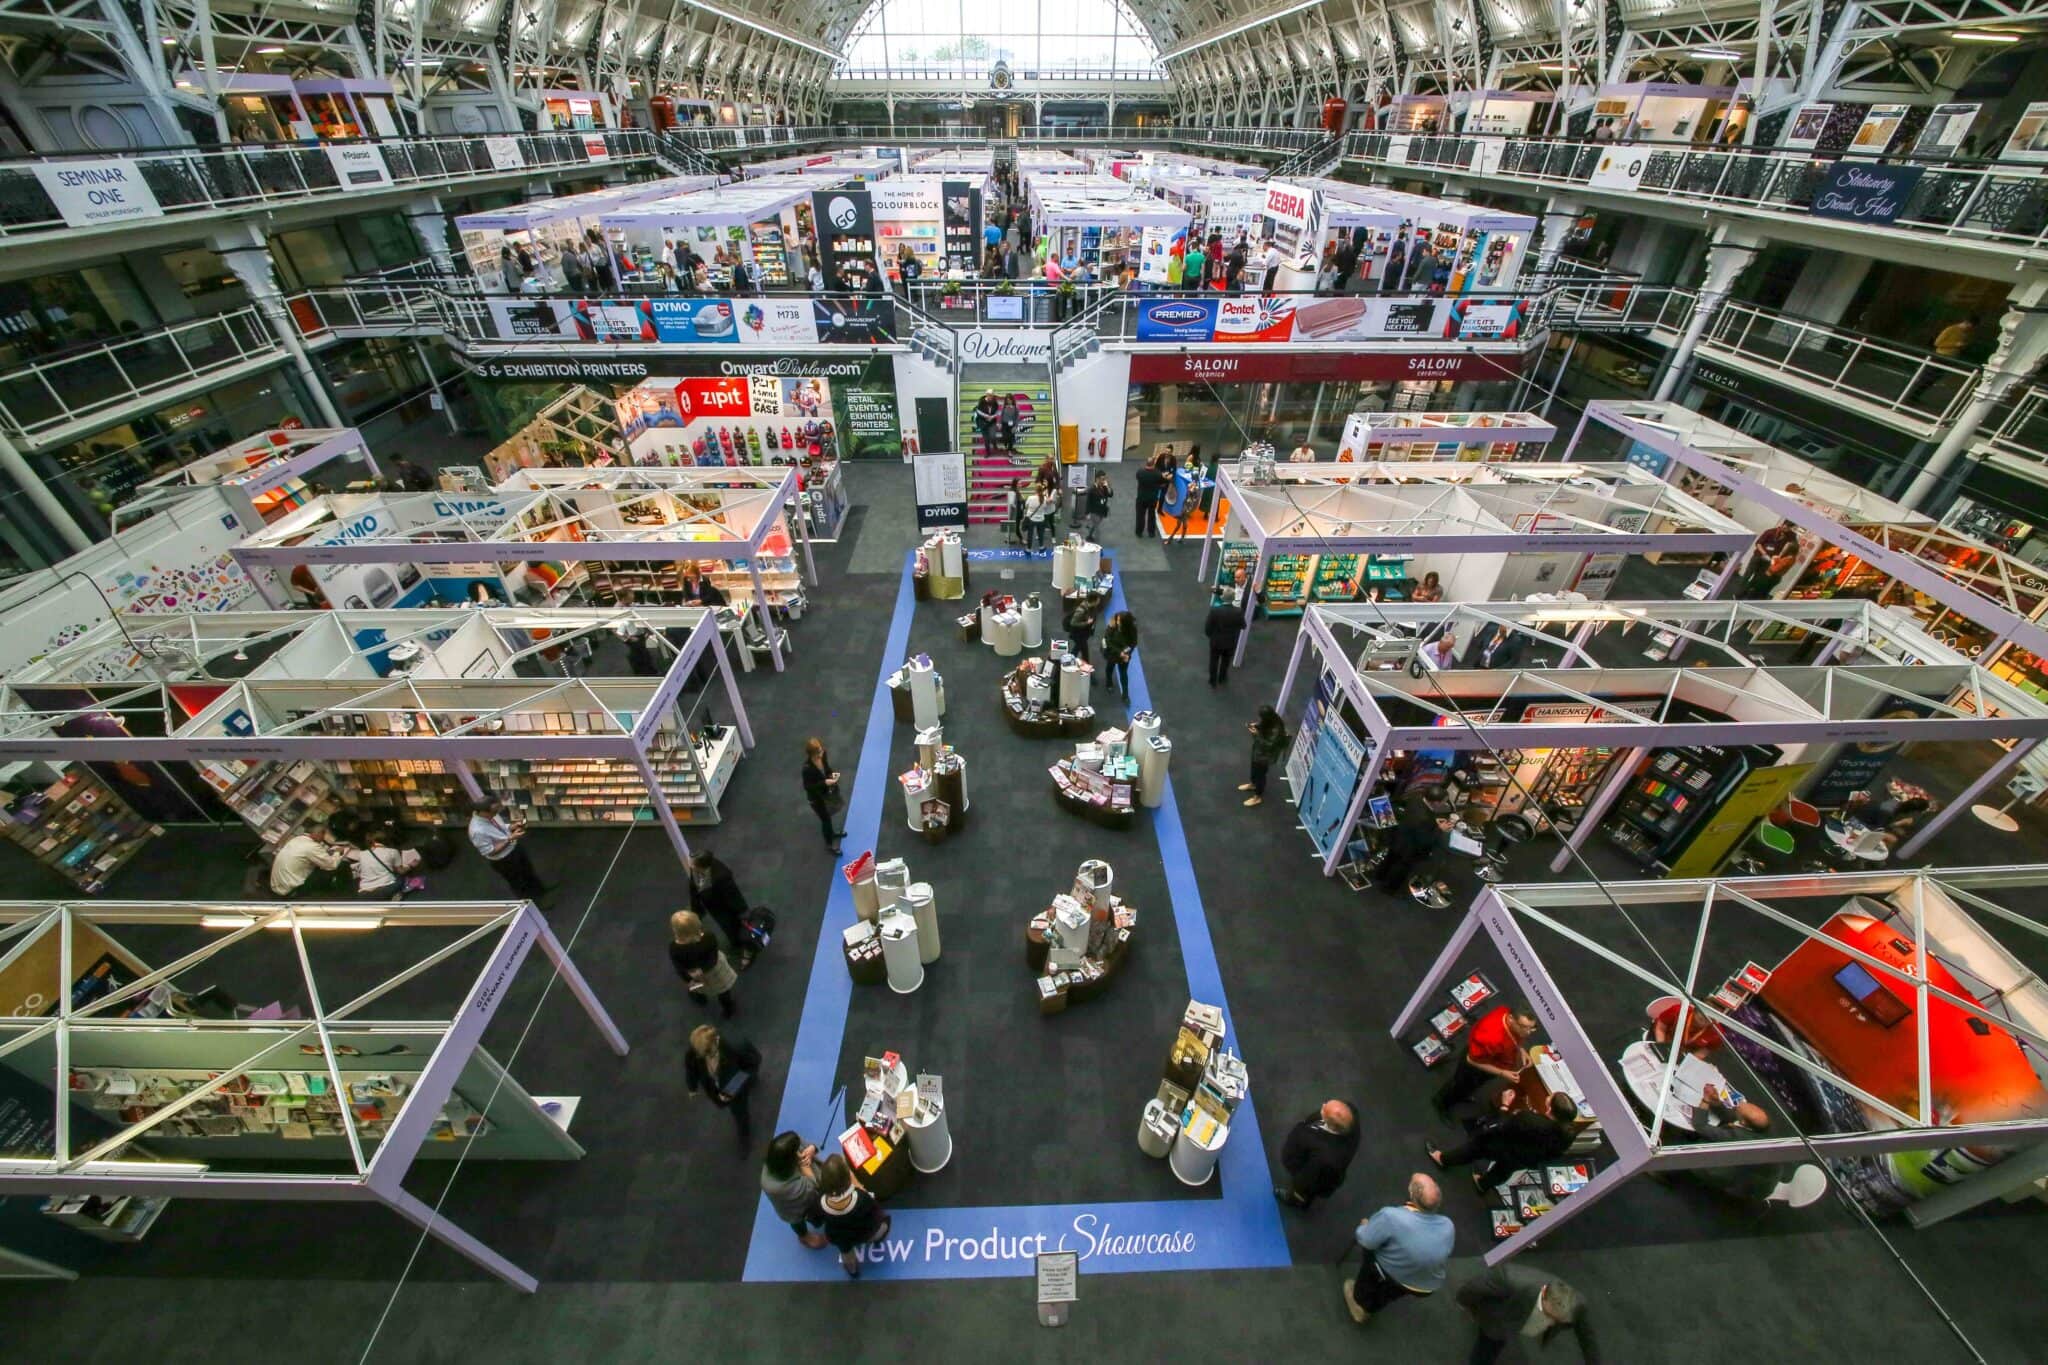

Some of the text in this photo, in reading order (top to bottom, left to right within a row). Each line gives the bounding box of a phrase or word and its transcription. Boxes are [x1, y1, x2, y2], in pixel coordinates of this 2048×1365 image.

[57, 168, 128, 187] SEMINAR
[1837, 168, 1896, 195] Stationery
[88, 188, 125, 206] ONE
[871, 201, 939, 209] COLOURBLOCK
[1267, 189, 1305, 220] ZEBRA
[1854, 196, 1897, 216] Hub
[835, 208, 857, 229] GO
[653, 302, 691, 312] DYMO
[1222, 302, 1256, 314] Pentel
[1155, 310, 1201, 319] PREMIER
[963, 331, 1047, 359] Welcome
[503, 364, 579, 377] EXHIBITION
[583, 364, 648, 376] PRINTERS
[1184, 359, 1239, 371] SALONI
[1408, 358, 1462, 369] SALONI
[752, 376, 777, 390] PUT
[701, 387, 744, 408] zipit
[754, 403, 779, 415] CASE
[849, 412, 893, 420] EXHIBITION
[169, 413, 189, 425] AVC
[924, 507, 960, 518] DYMO
[1537, 705, 1590, 717] HAINENKO
[1333, 721, 1360, 760] CROWN
[480, 931, 529, 1012] STEWART SUPERIOR
[1507, 941, 1534, 985] POSTSAFE
[1532, 984, 1556, 1021] LIMITED
[925, 1227, 1047, 1262] Product
[1058, 1213, 1196, 1262] Showcase
